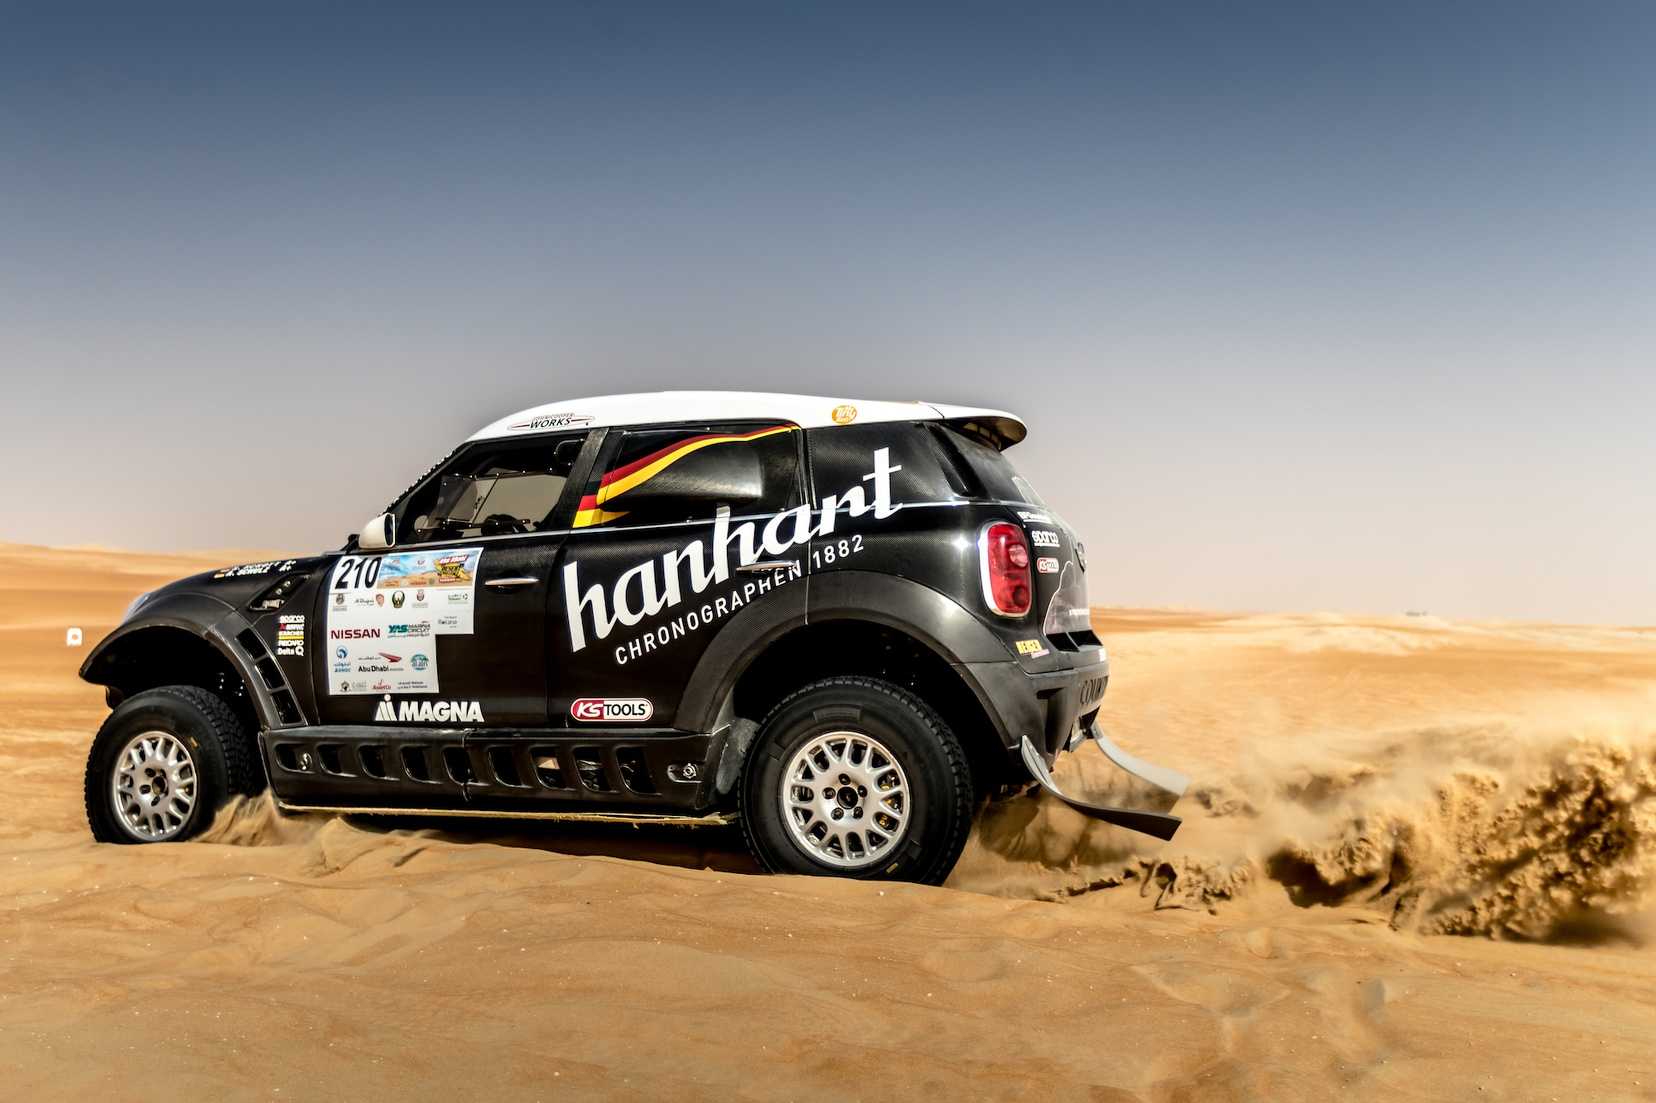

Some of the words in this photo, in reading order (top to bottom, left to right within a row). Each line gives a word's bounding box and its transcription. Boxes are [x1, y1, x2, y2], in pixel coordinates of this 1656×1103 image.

[530, 417, 572, 429] WORKS
[563, 446, 903, 653] hanhart
[335, 556, 382, 590] 210
[615, 559, 802, 665] CHRONOGRAPHEN
[813, 534, 865, 570] 1882
[331, 628, 381, 640] NISSAN
[388, 624, 408, 633] YAS
[295, 645, 304, 657] Q
[358, 665, 370, 673] Abu
[371, 663, 390, 672] Dhabi
[400, 700, 485, 723] MAGNA
[576, 702, 604, 718] KS
[603, 704, 646, 716] TOOLS
